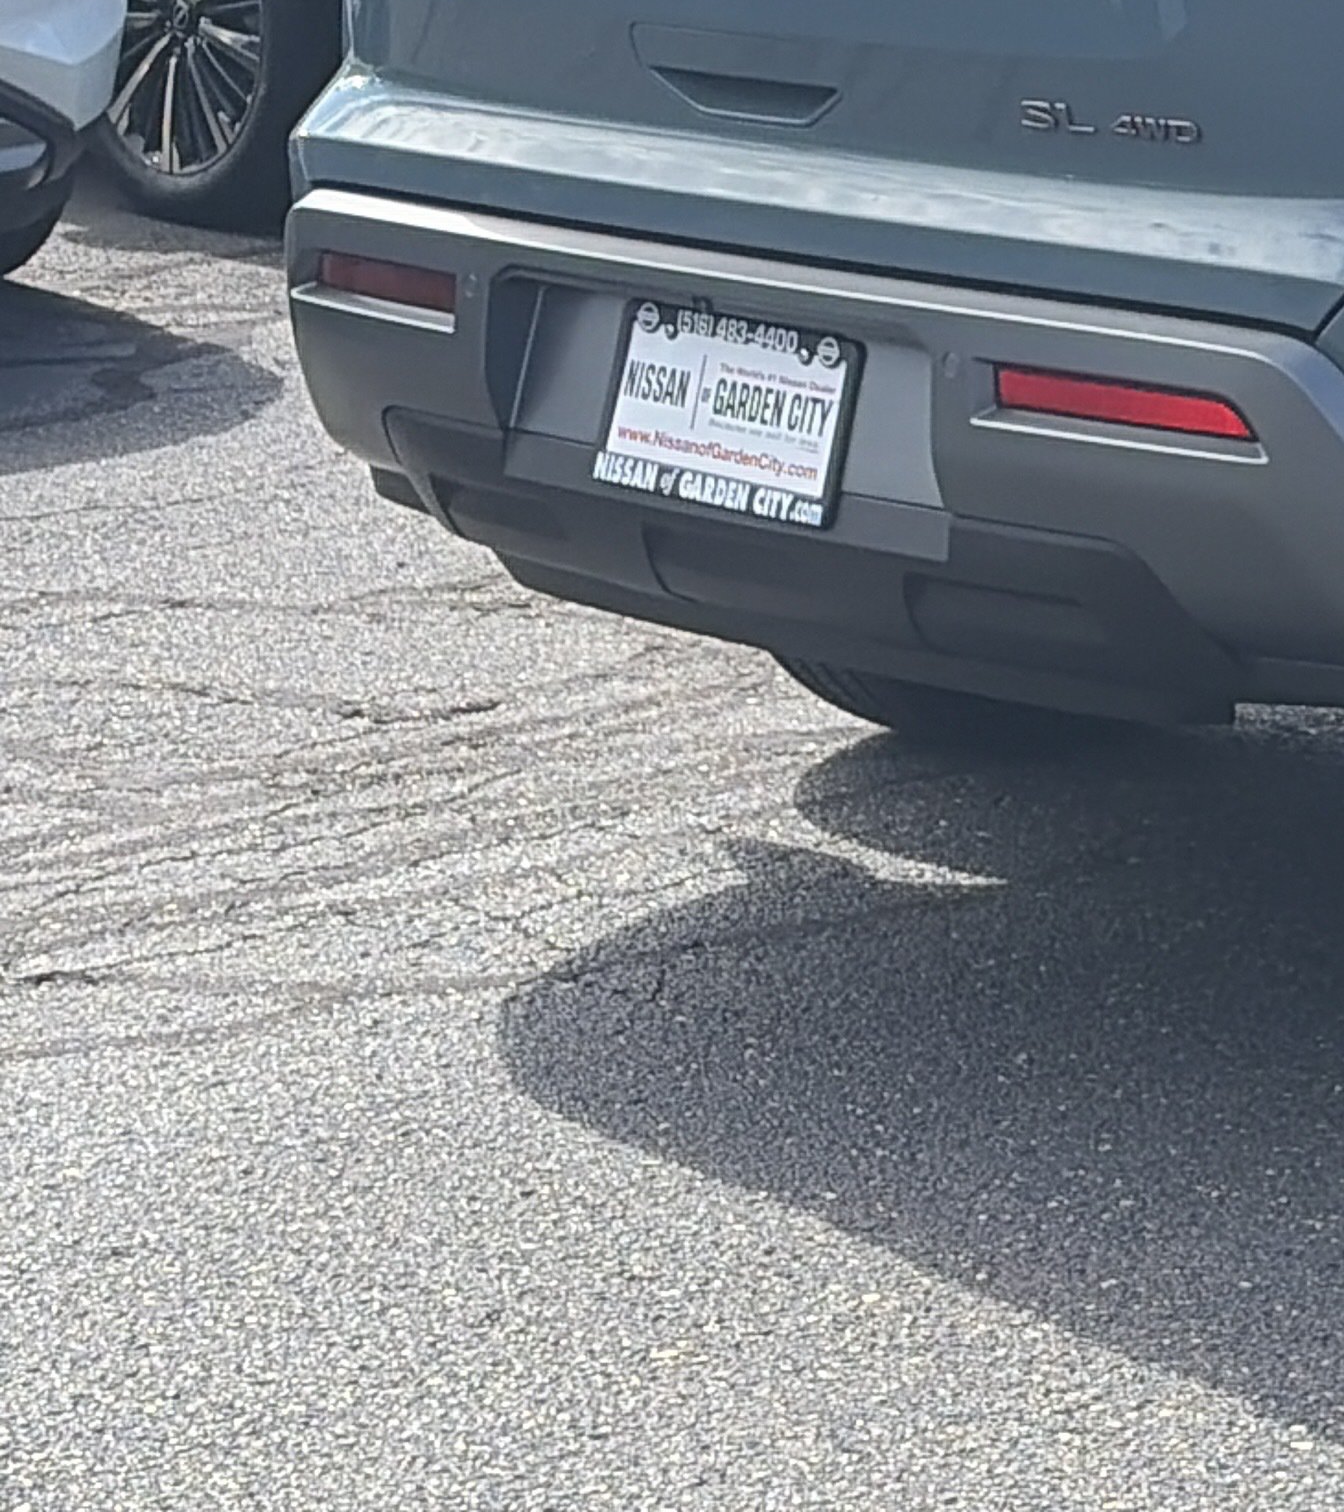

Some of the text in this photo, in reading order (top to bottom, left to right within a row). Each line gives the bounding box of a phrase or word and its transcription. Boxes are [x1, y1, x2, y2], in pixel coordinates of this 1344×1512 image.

[1020, 99, 1200, 143] SL 4WD
[716, 316, 799, 353] 483-4400
[623, 359, 692, 409] NISSAN
[712, 376, 788, 429] GARDEN
[787, 392, 835, 438] CITY
[618, 425, 818, 481] www.NissanofGardenCity.com
[592, 450, 824, 527] NISSAN of GARDEN CITY.com
